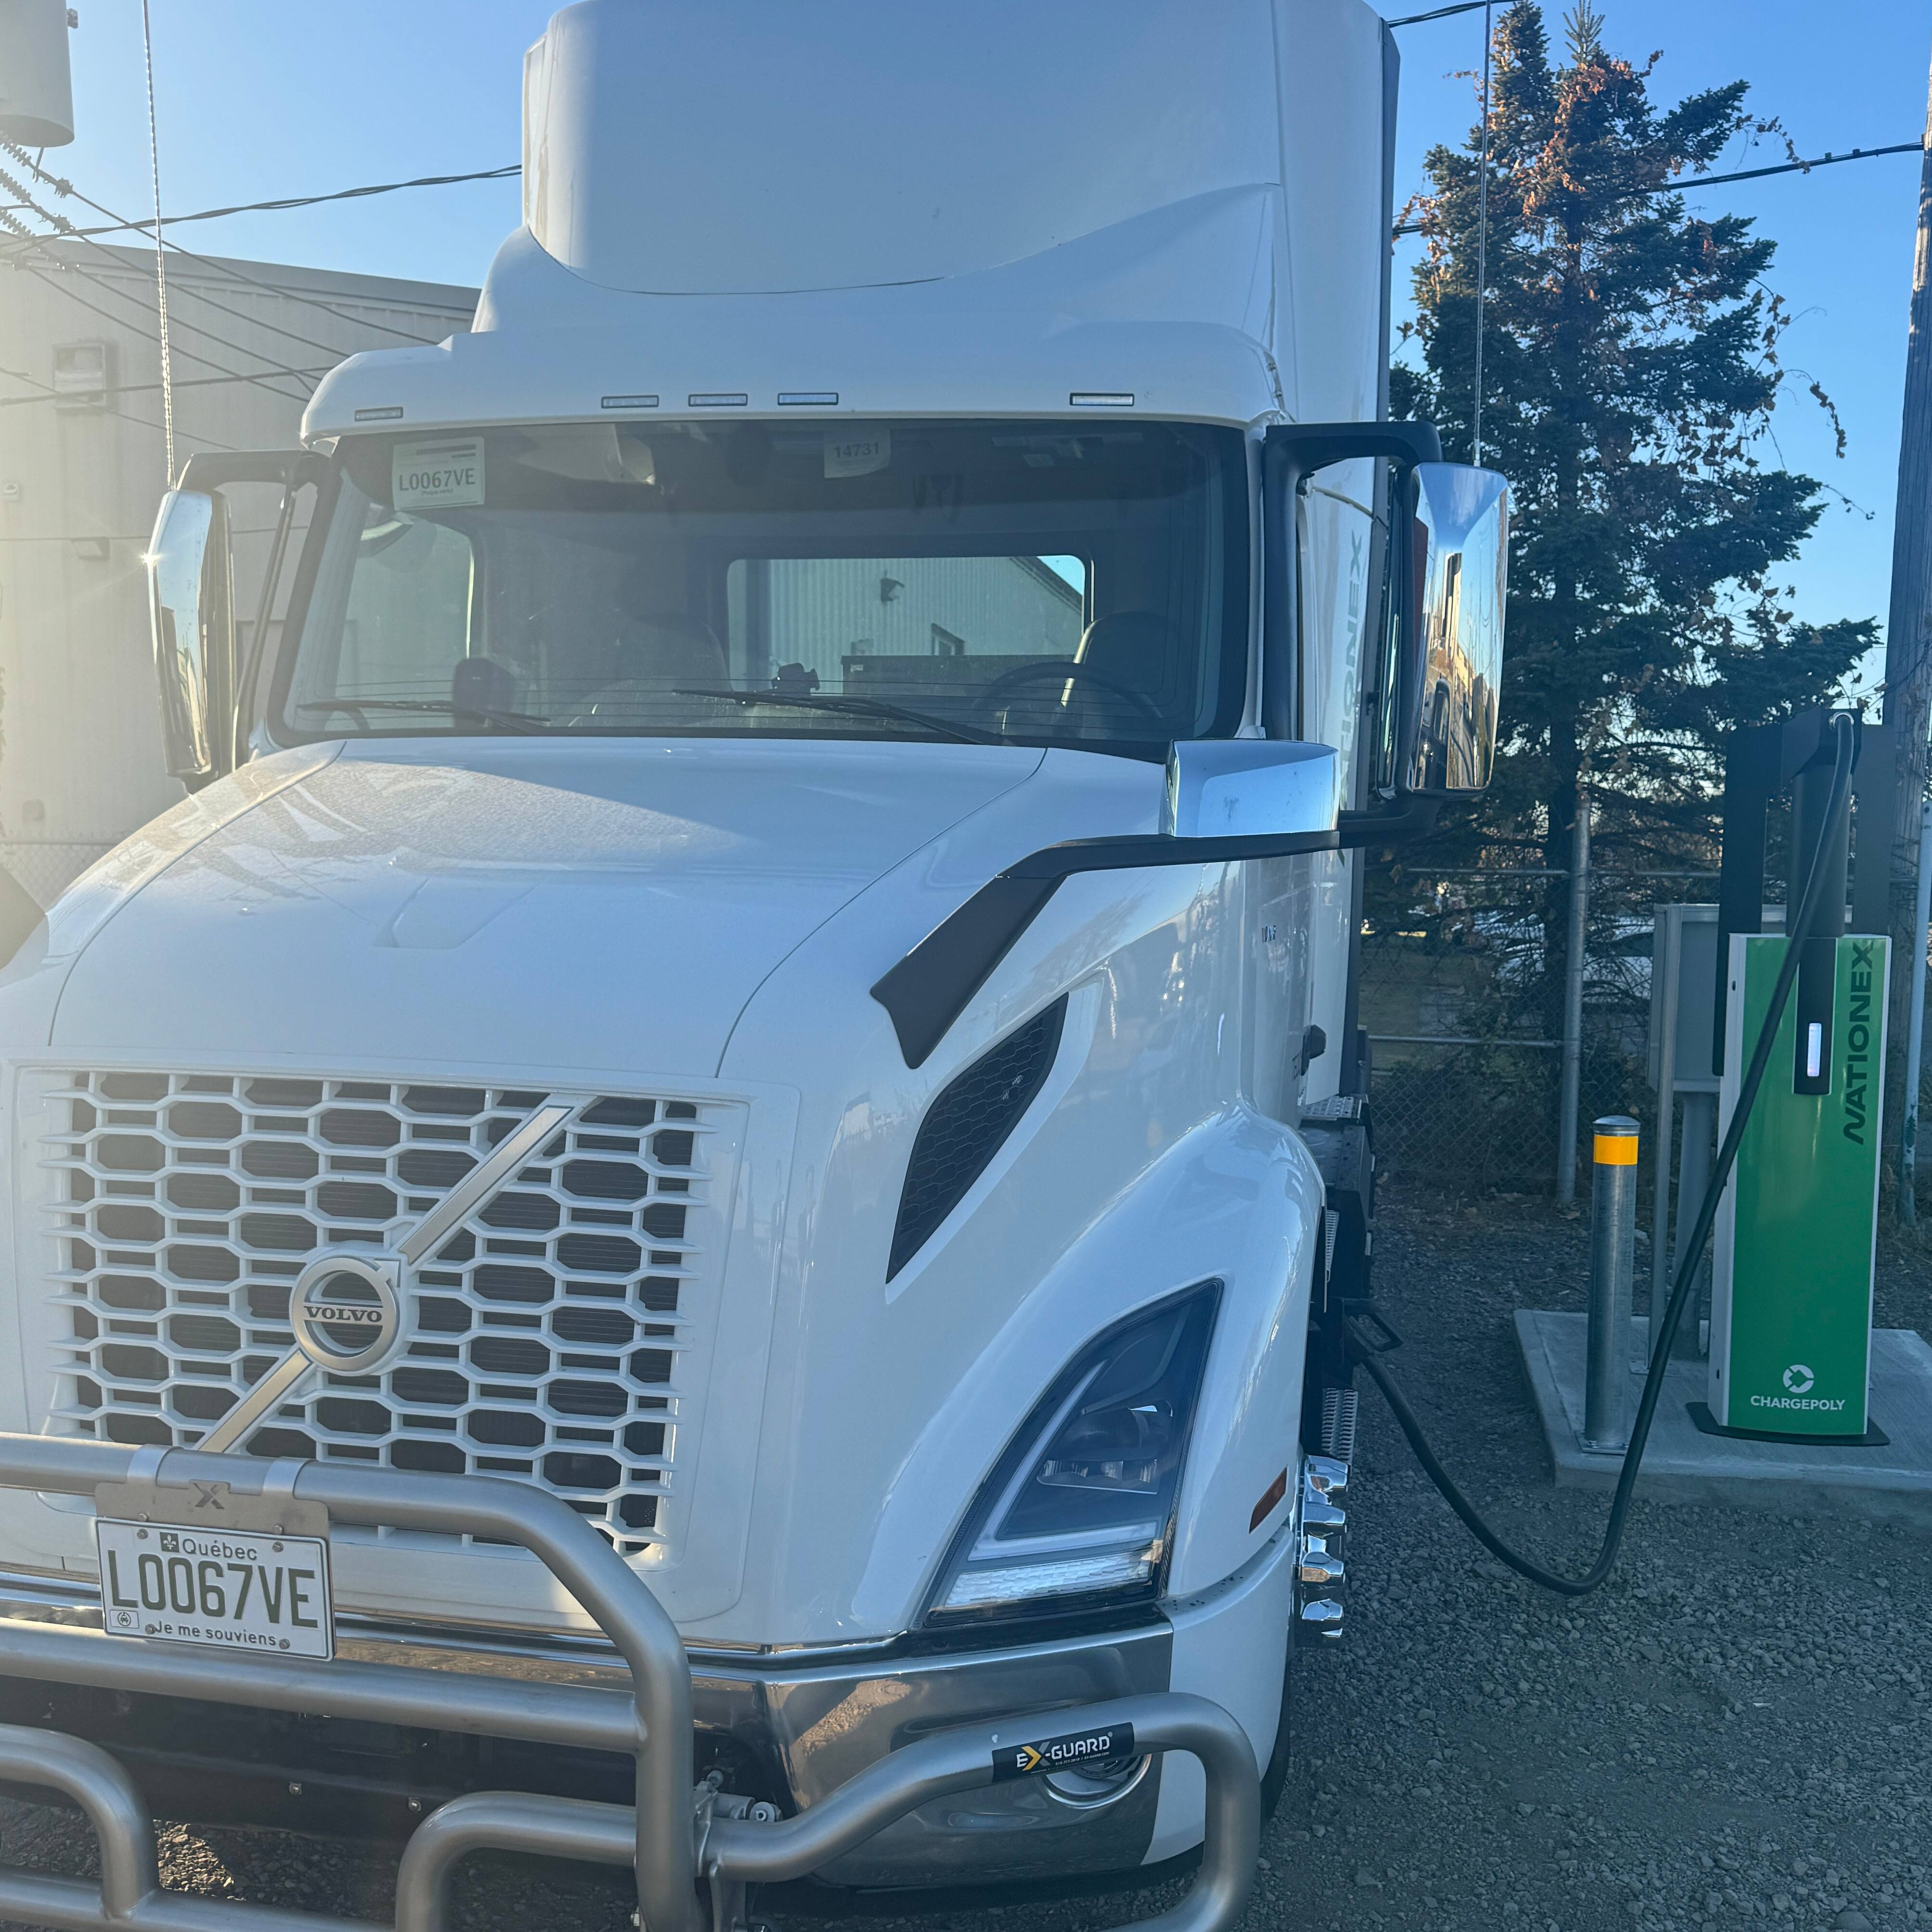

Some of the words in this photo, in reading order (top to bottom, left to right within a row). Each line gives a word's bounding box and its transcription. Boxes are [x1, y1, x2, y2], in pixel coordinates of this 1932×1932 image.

[834, 441, 879, 458] 14731
[399, 468, 476, 491] L0067VE
[1843, 941, 1874, 1145] NATIONEX
[304, 1306, 382, 1323] VOLVO
[1750, 1395, 1845, 1410] CHARGEPOLY
[182, 1538, 258, 1561] Québec
[108, 1549, 318, 1628] L0067VE
[154, 1620, 173, 1634] Je
[178, 1625, 201, 1637] me
[206, 1628, 276, 1646] souviens
[1016, 1736, 1110, 1771] EX-GUARD
